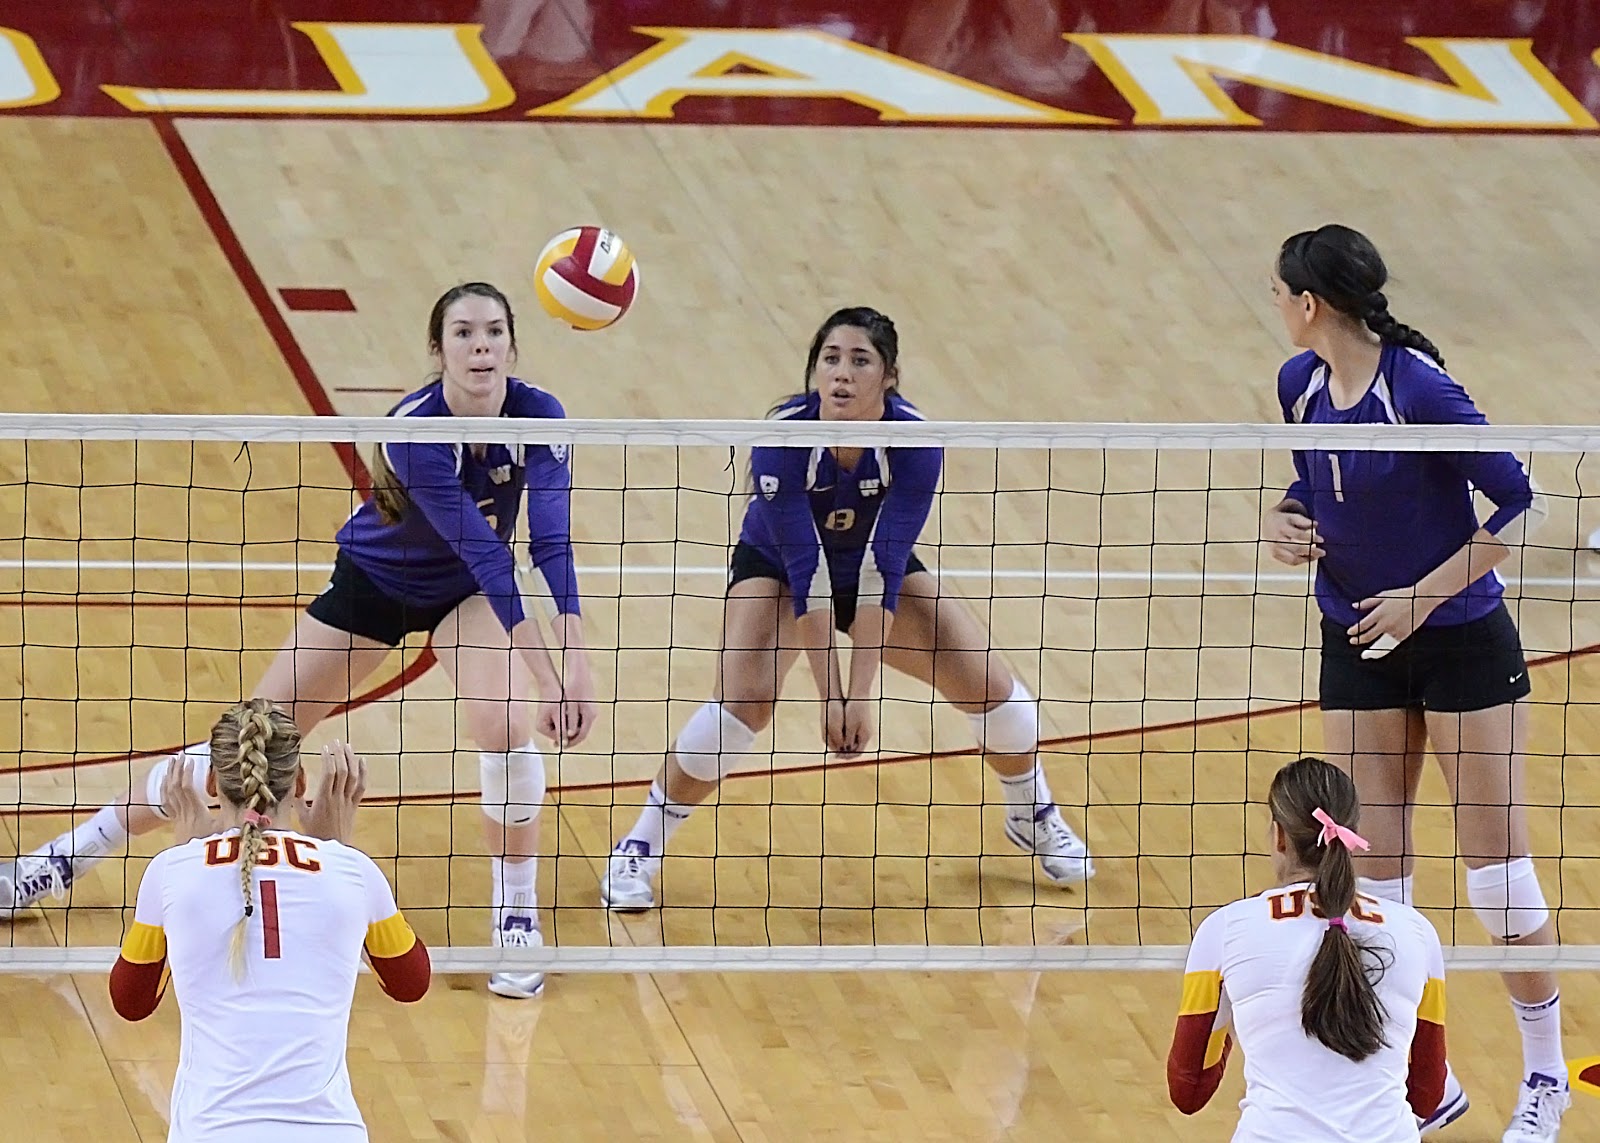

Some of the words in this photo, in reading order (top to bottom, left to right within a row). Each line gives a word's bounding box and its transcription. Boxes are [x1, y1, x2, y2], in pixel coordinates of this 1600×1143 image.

[0, 22, 1600, 130] JAN
[488, 463, 512, 485] W
[1328, 453, 1345, 503] 1
[259, 879, 282, 960] 1
